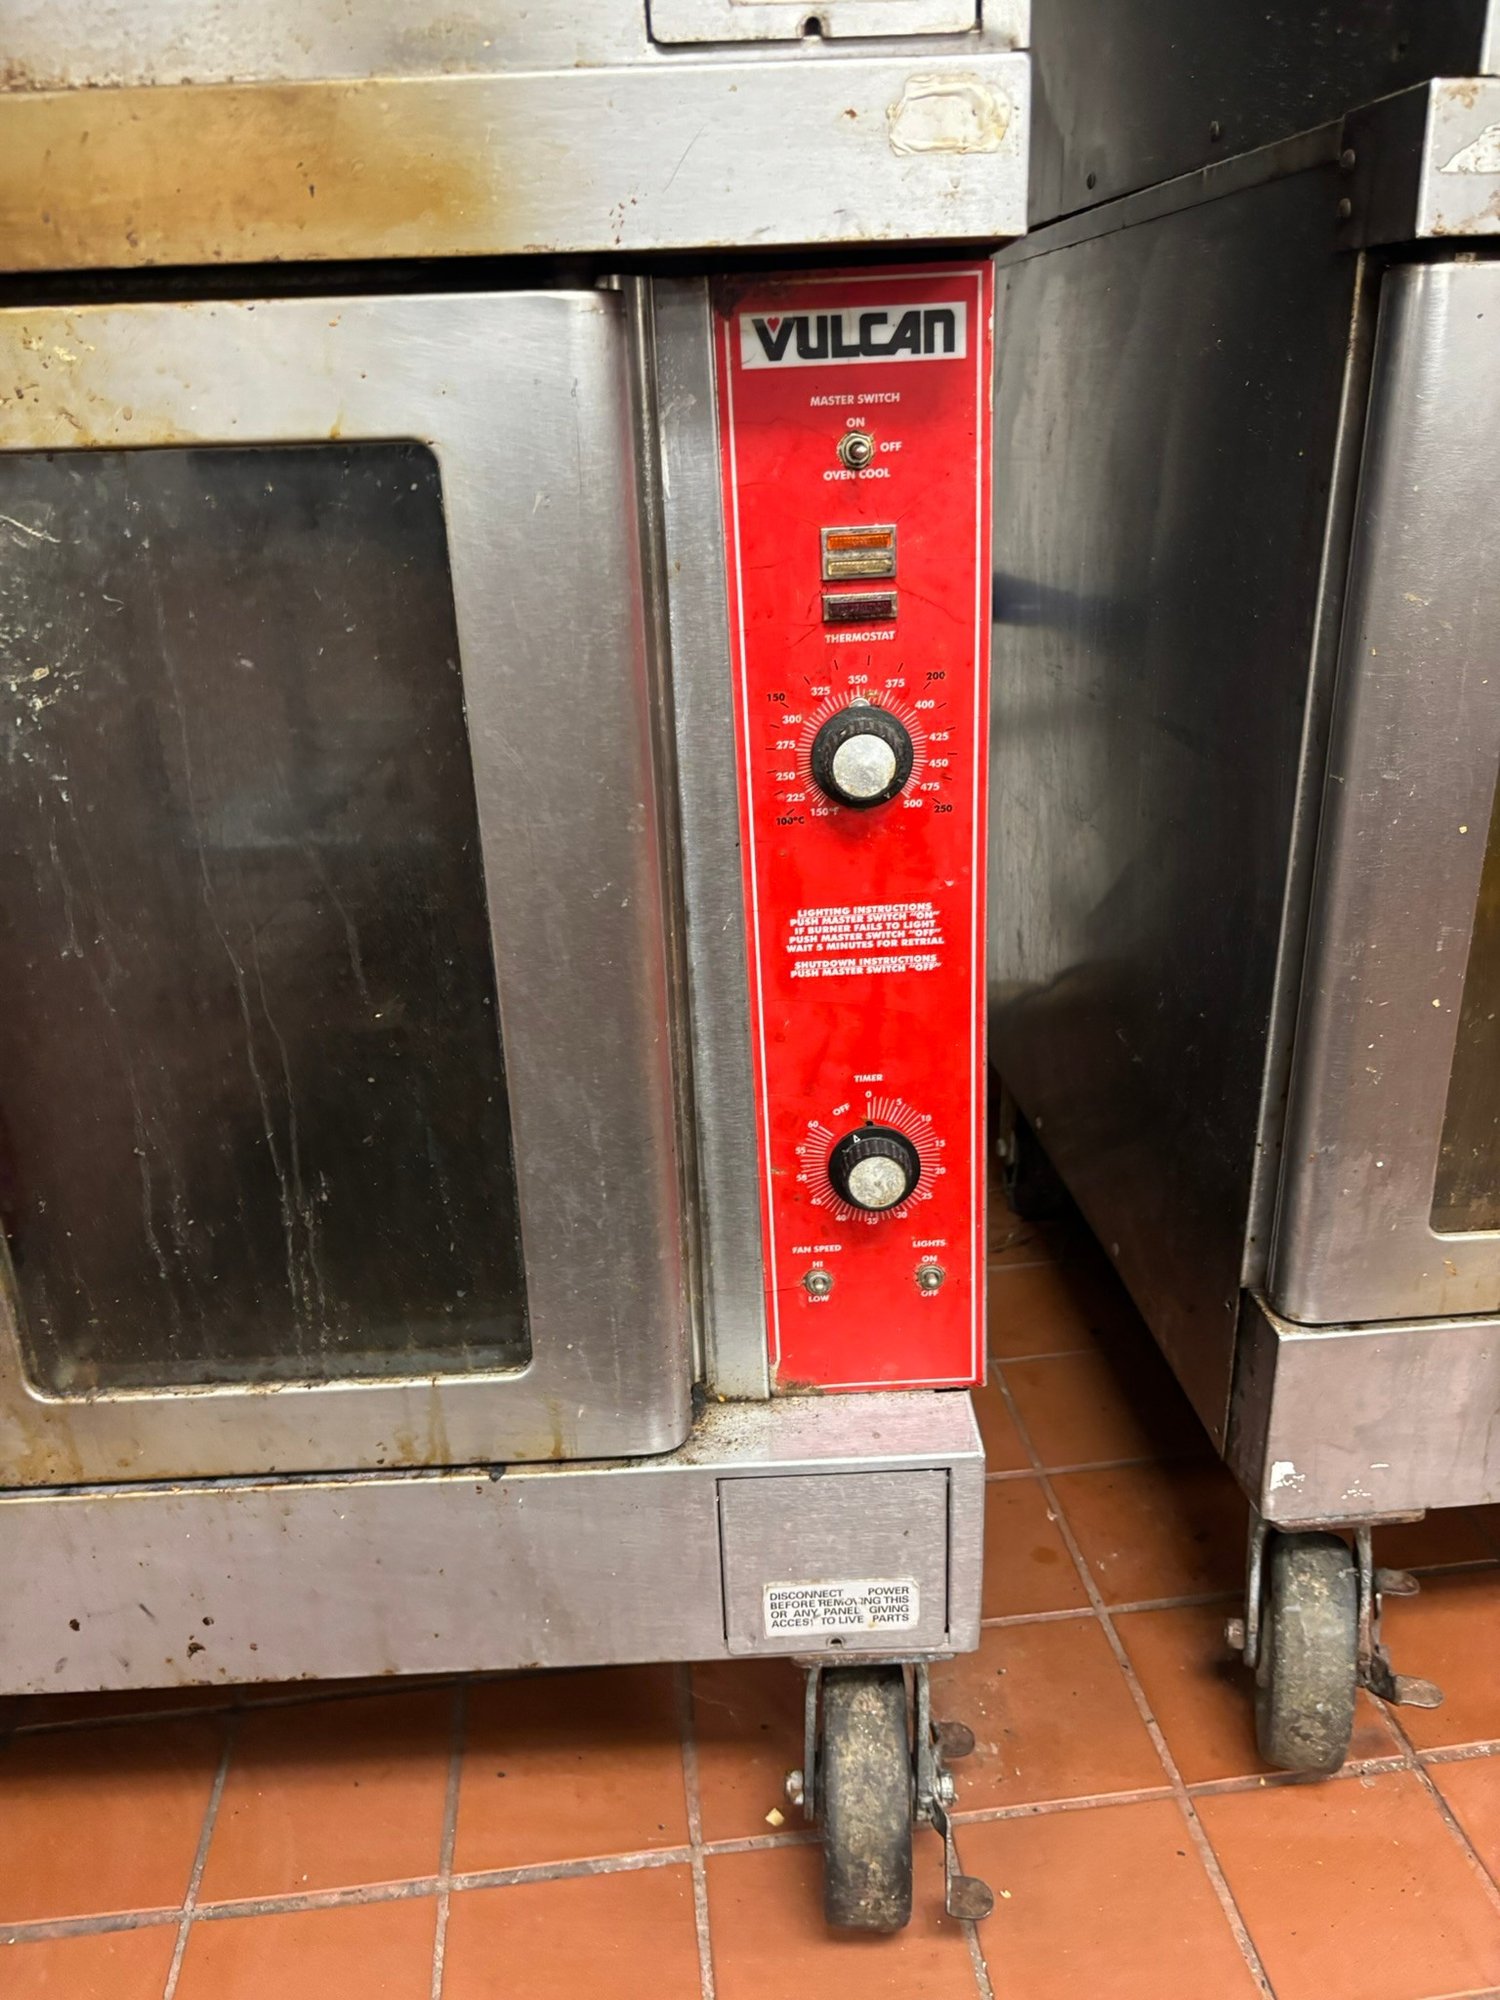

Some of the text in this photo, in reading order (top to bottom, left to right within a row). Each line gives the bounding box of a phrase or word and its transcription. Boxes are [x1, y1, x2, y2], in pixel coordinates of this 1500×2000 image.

[752, 309, 955, 361] VULCAN
[811, 393, 900, 406] MASTER SWITCH
[846, 417, 865, 428] ON
[880, 441, 902, 452] OFF
[823, 468, 890, 480] OVEN COOL
[825, 630, 895, 643] THERMOSTAT
[848, 676, 868, 684] 350
[927, 672, 945, 680] 200
[885, 679, 905, 687] 375
[811, 687, 830, 695] 325
[782, 715, 801, 723] 300
[929, 733, 948, 741] 425
[776, 741, 795, 749] 275
[776, 772, 795, 780] 250
[920, 783, 939, 791] 475
[904, 800, 922, 808] 500
[934, 805, 952, 813] 250
[777, 816, 805, 825] 100°C
[798, 902, 932, 917] LIGHTING INSTRUCTIONS
[790, 918, 818, 926] PUSH
[822, 914, 864, 924] MASTER
[867, 912, 906, 922] SWITCH
[795, 927, 804, 935] IF
[808, 924, 850, 934] BURNER
[854, 922, 882, 932] FAILS
[904, 920, 936, 928] LIGHT
[789, 936, 817, 944] PUSH
[821, 932, 862, 942] MASTER
[866, 931, 905, 940] SWITCH
[786, 944, 813, 952] WAIT
[826, 941, 873, 950] MINUTES
[901, 938, 944, 946] RETRIAL
[795, 954, 937, 969] SHUTDOWN INSTRUCTIONS
[790, 969, 818, 978] PUSH
[822, 967, 863, 976] MASTER
[866, 964, 906, 974] SWITCH
[854, 1074, 883, 1082] TIMER
[897, 1098, 902, 1106] 5
[833, 1103, 850, 1116] OFF
[808, 1120, 819, 1128] 60
[912, 1240, 946, 1248] LIGHTS
[808, 1295, 829, 1303] LOW
[770, 1587, 909, 1600] DISCONNECT POWER
[771, 1601, 815, 1610] BEFORE
[884, 1595, 909, 1603] THIS
[771, 1605, 909, 1618] OR ANY PANEL GIVING
[821, 1617, 836, 1625] TO
[839, 1616, 863, 1624] LIVE
[872, 1614, 909, 1622] PARTS
